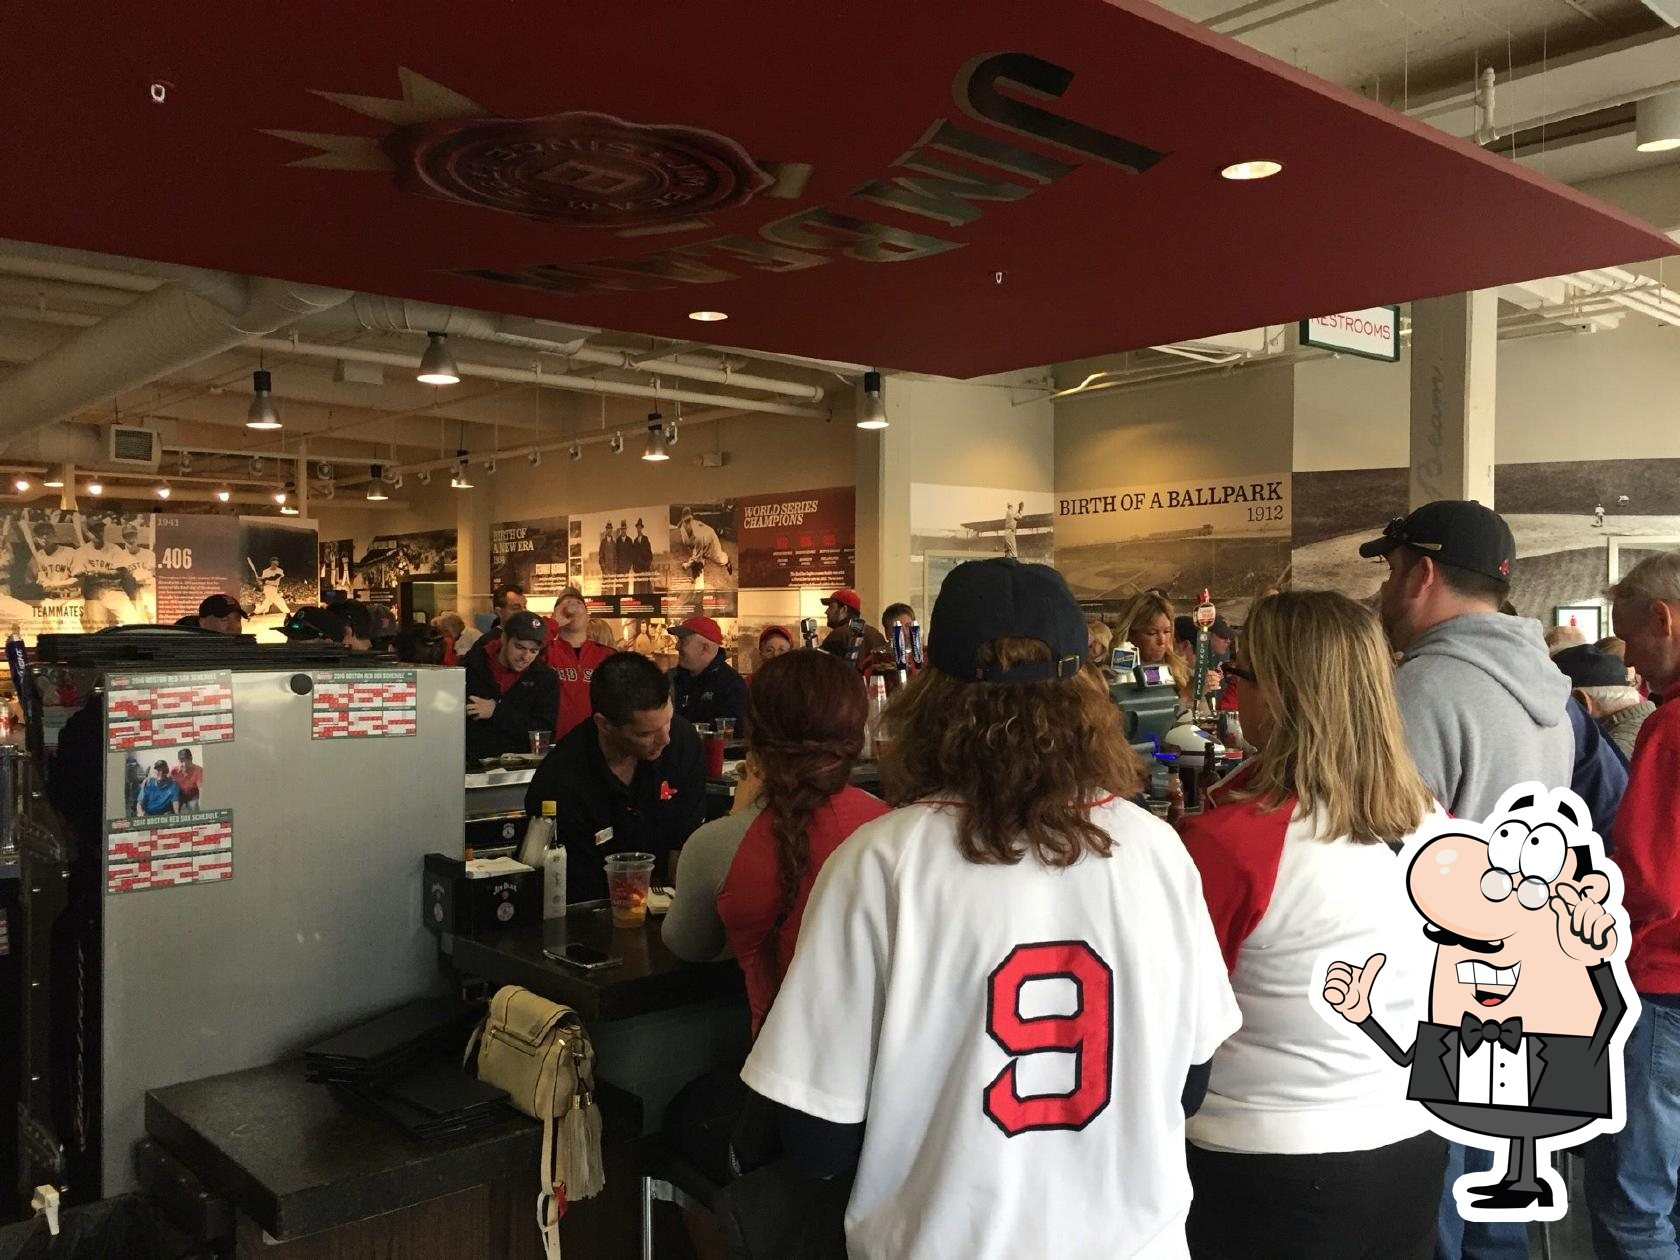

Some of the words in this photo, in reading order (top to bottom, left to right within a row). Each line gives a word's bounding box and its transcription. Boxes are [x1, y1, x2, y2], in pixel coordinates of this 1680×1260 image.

[850, 51, 1174, 227] JIM
[1059, 495, 1117, 516] BIRTH
[1120, 492, 1146, 511] OF
[1149, 492, 1164, 509] A
[1167, 481, 1284, 508] BALLPARK
[744, 504, 780, 518] WORLD
[780, 500, 819, 515] SERIES
[1247, 505, 1284, 522] 1912
[743, 513, 804, 529] CHAMPIONS
[516, 527, 527, 539] OF
[517, 540, 535, 552] ERA
[157, 547, 192, 569] .406
[32, 605, 84, 618] TEAMMATES
[983, 940, 1114, 1138] 9
